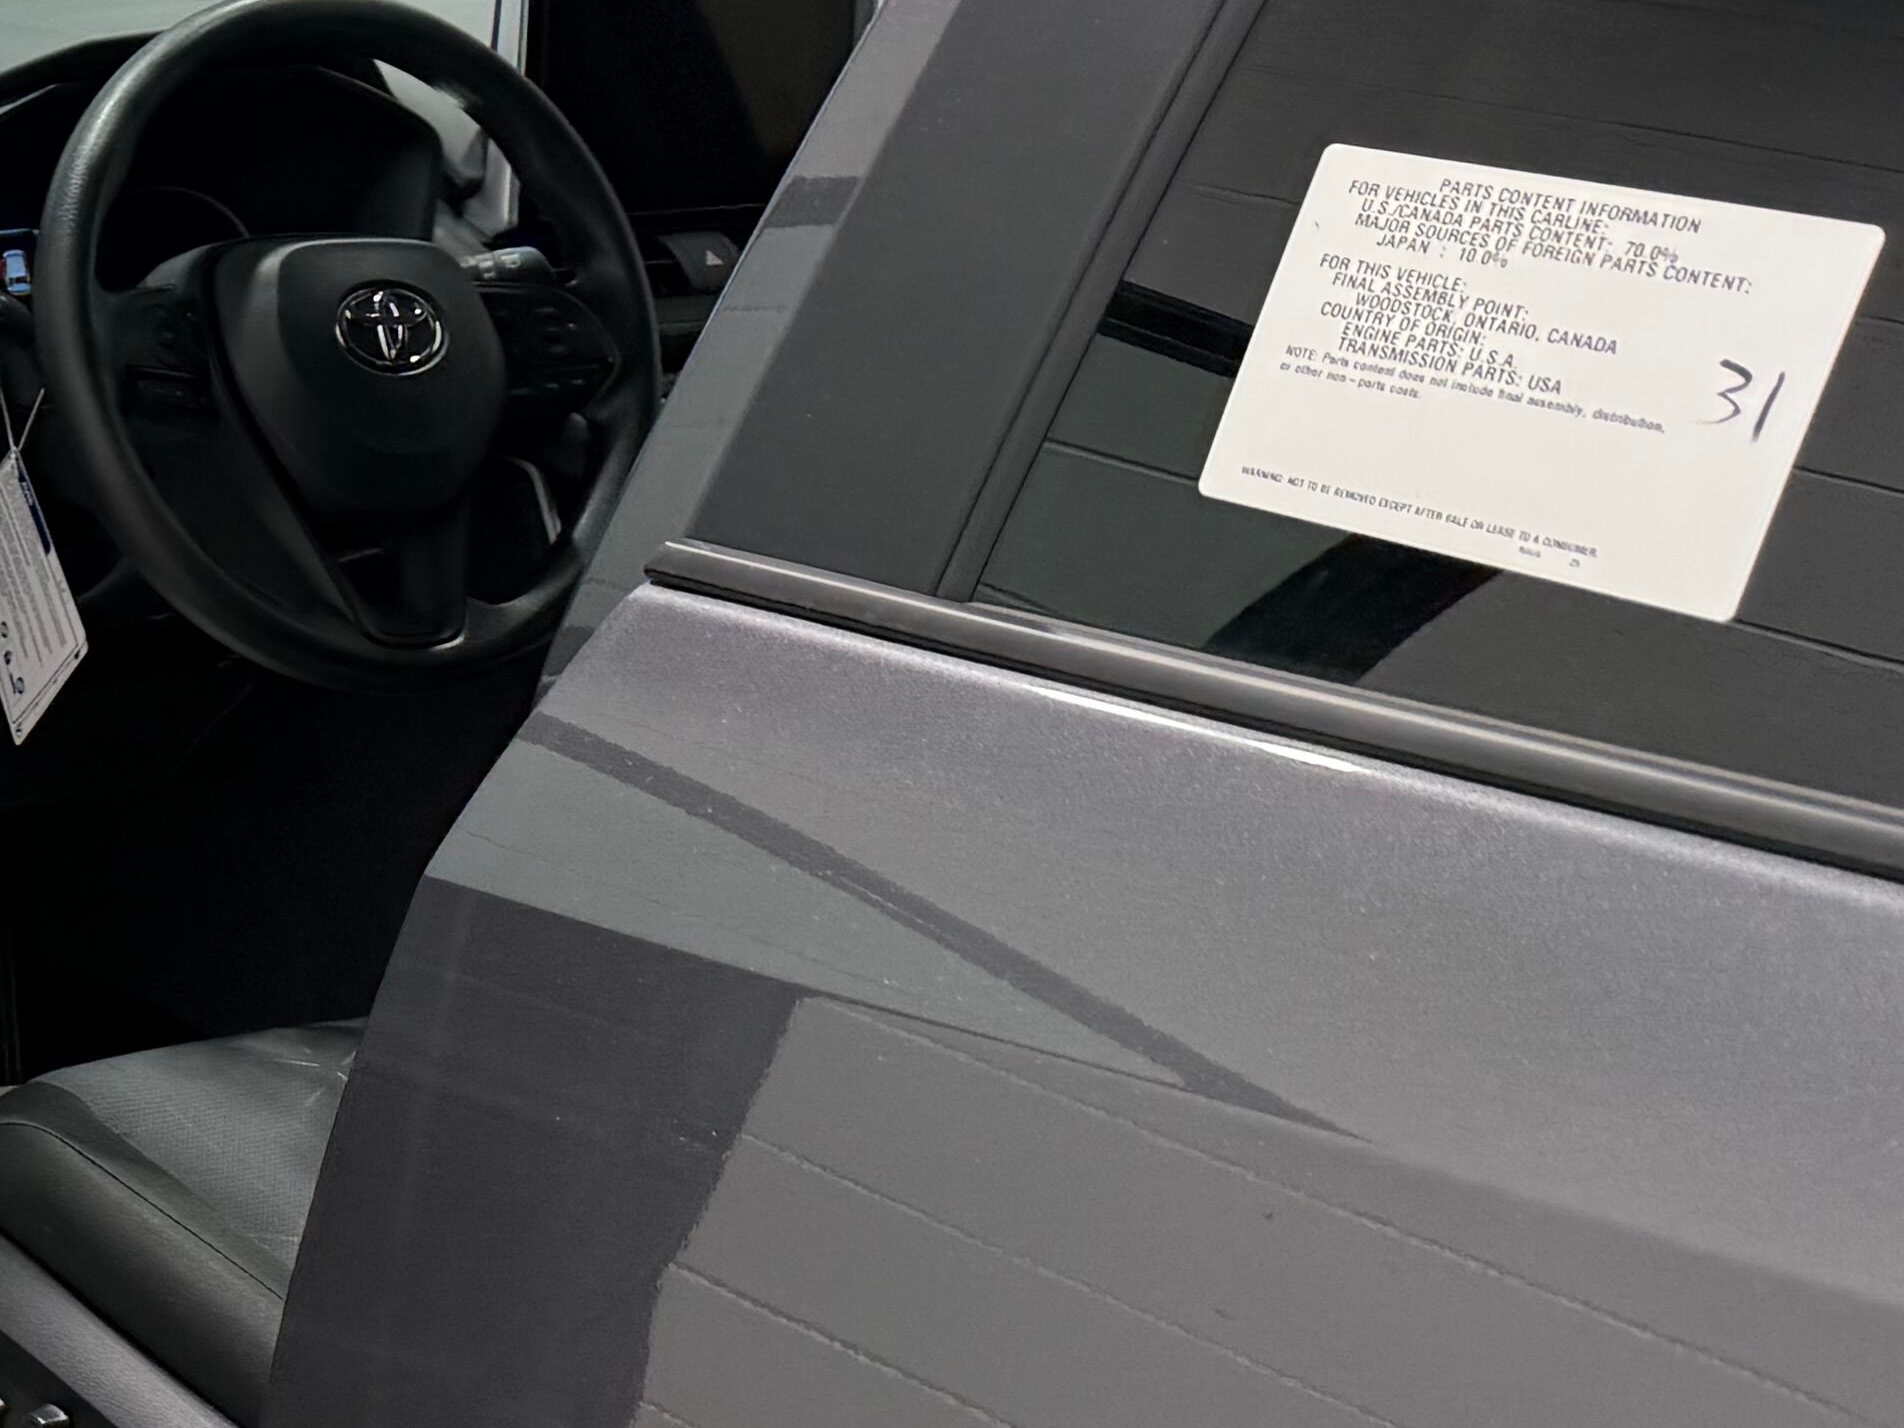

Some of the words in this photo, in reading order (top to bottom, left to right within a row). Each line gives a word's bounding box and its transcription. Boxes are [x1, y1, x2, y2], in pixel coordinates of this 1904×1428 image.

[1347, 181, 1381, 198] FOR
[1383, 186, 1460, 210] VEHICLES
[1463, 199, 1483, 214] IN
[1487, 202, 1527, 221] THIS
[1529, 209, 1610, 234] CARLINE:
[1438, 179, 1494, 200] PARTS
[1496, 188, 1575, 212] CONTENT
[1578, 200, 1702, 232] INFORMATION
[1353, 213, 1410, 235] MAJOR
[1413, 223, 1491, 248] SOURCES
[1493, 236, 1517, 253] OF
[1521, 241, 1596, 266] FOREIGN
[1599, 253, 1659, 276] PARTS
[1662, 264, 1754, 292] CONTENT:
[1375, 233, 1430, 254] JAPAN
[1468, 216, 1524, 237] PARTS
[1527, 225, 1614, 251] CONTENT:
[1319, 254, 1351, 271] FOR
[1355, 260, 1392, 278] THIS
[1394, 267, 1468, 292] VEHICLE:
[1331, 273, 1378, 292] FINAL
[1380, 281, 1469, 308] ASSEMBLY
[1472, 298, 1530, 319] POINT:
[1319, 302, 1394, 327] COUNTRY
[1398, 317, 1420, 332] OF
[1423, 322, 1487, 345] ORIGIN:
[1341, 322, 1400, 345] ENGINE
[1404, 334, 1464, 357] PARTS:
[1462, 312, 1543, 339] ONTARIO,
[1545, 327, 1620, 354] CANADA
[1337, 337, 1458, 373] TRANSMISSION
[1460, 361, 1523, 386] PARTS:
[1526, 374, 1564, 394] USA
[1701, 358, 1786, 443] 31
